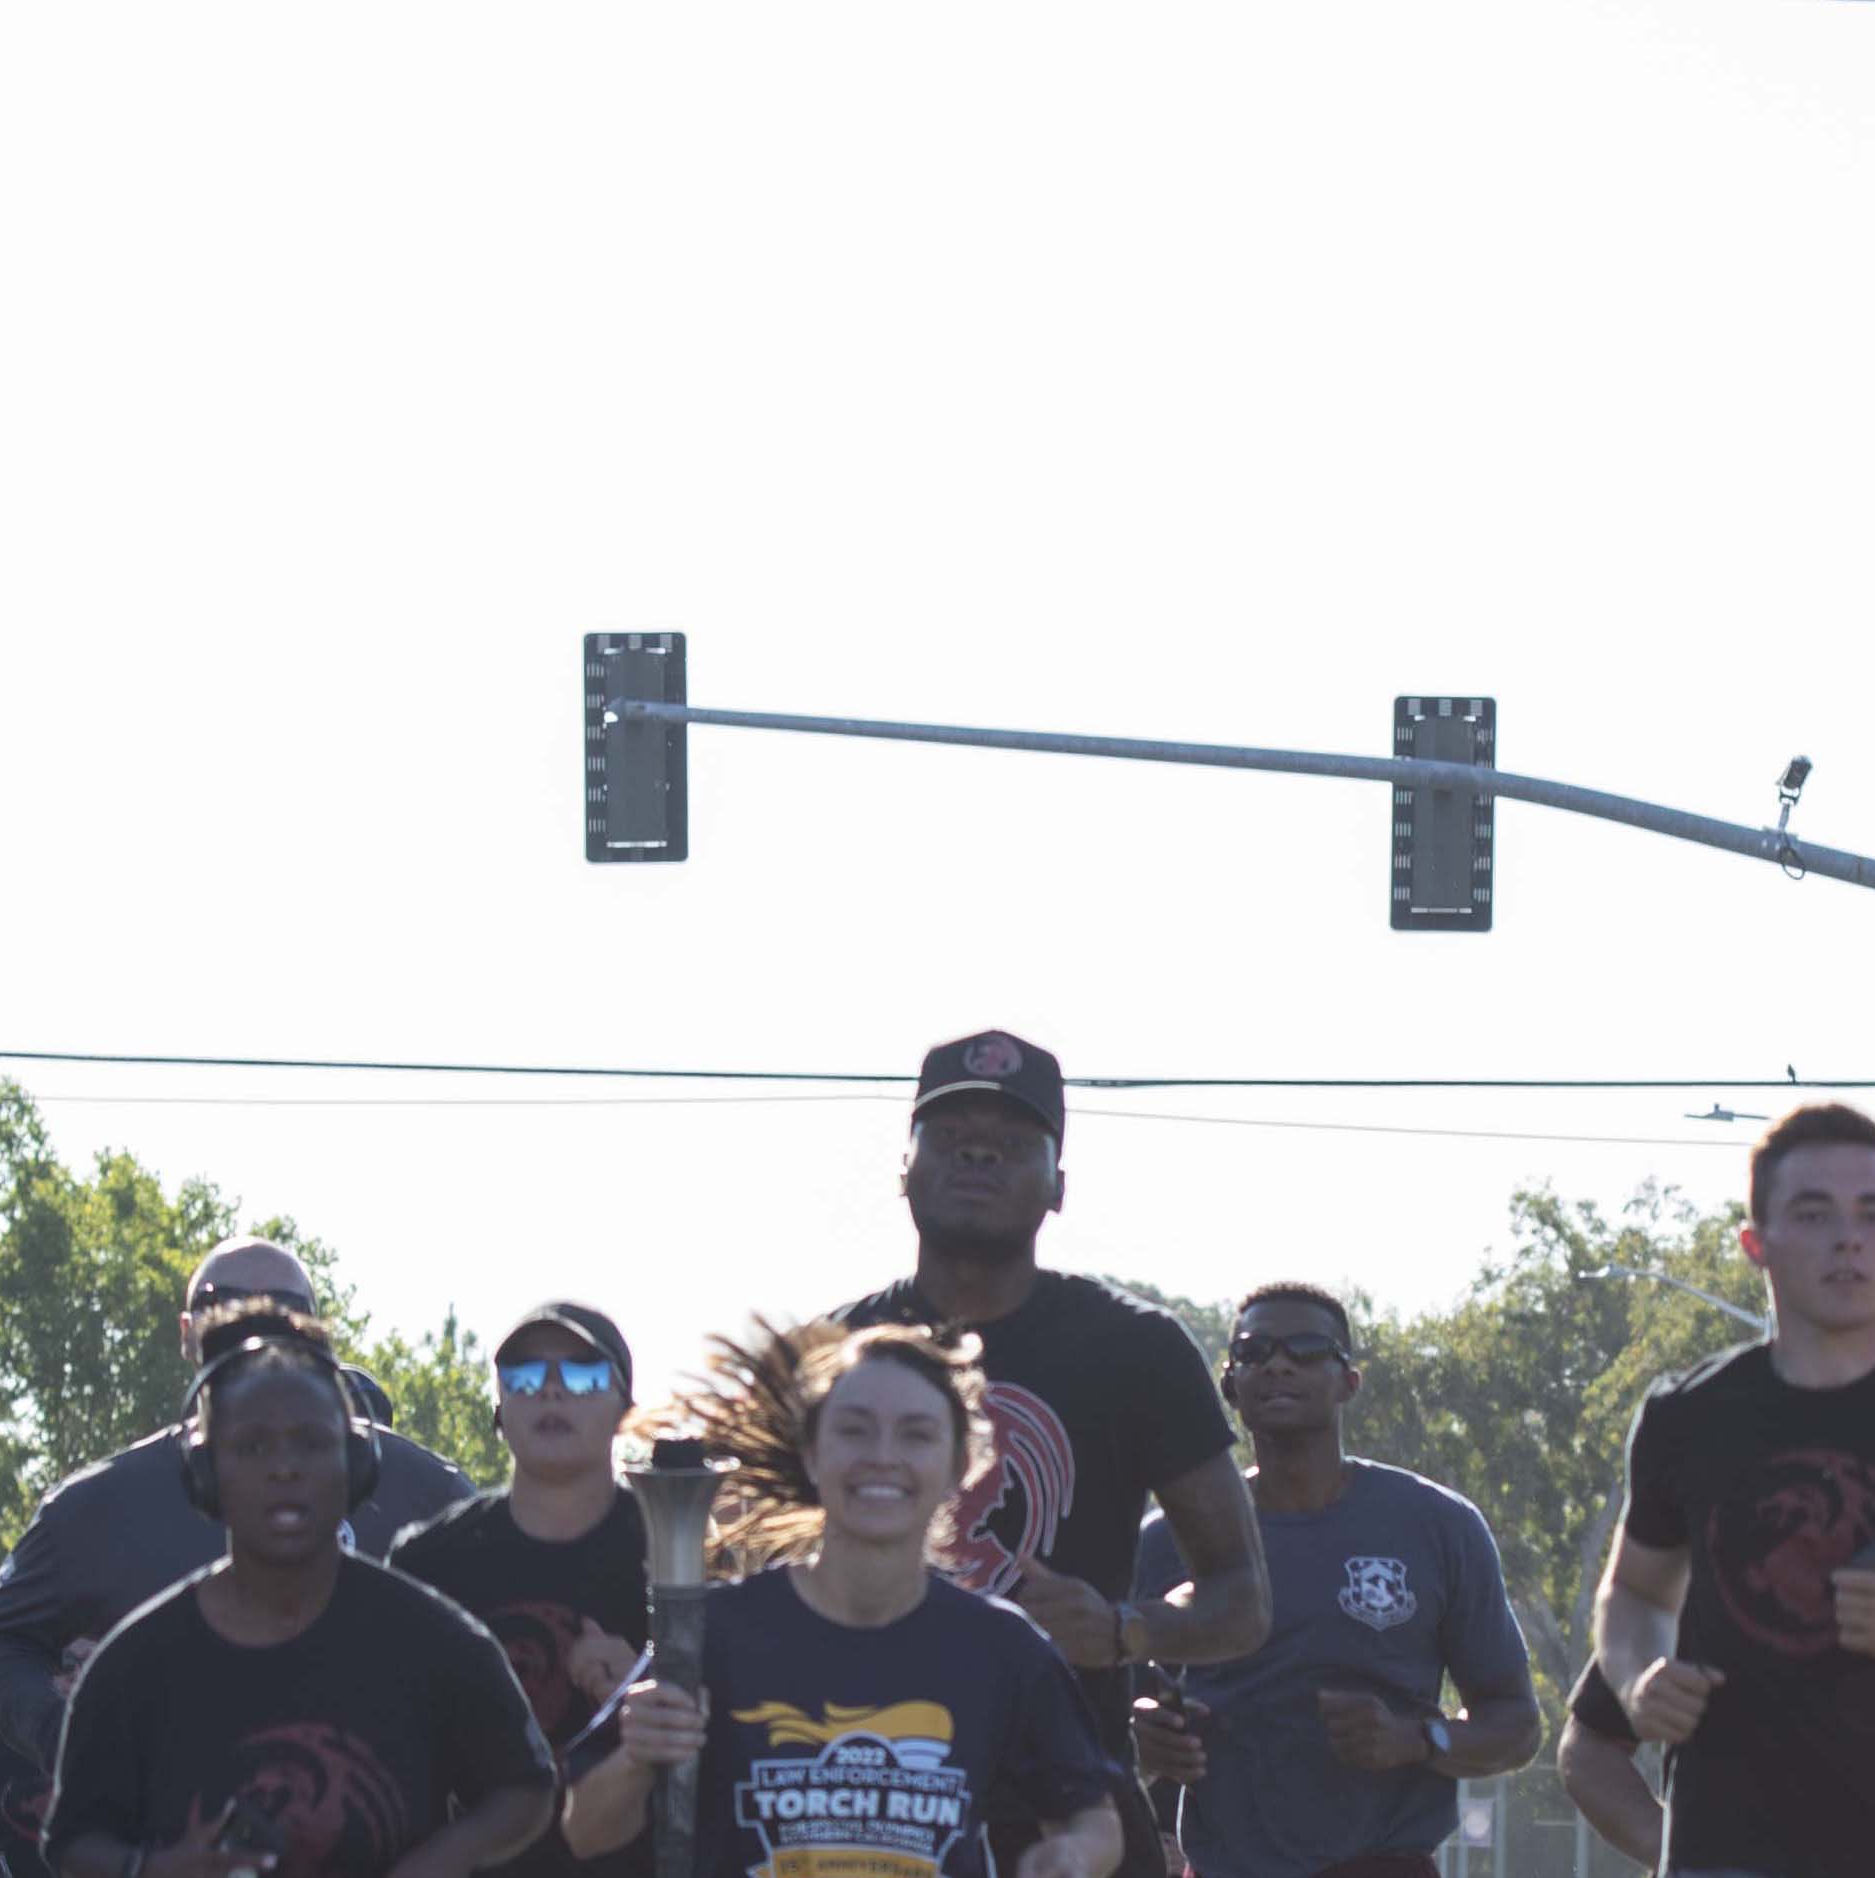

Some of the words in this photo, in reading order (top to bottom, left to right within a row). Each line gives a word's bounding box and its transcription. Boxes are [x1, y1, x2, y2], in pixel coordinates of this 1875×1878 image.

[834, 1745, 888, 1766] 2022
[761, 1768, 805, 1787] LAW
[808, 1767, 958, 1795] ENFORCEMENT
[753, 1787, 881, 1820] TORCH
[886, 1791, 962, 1826] RUN
